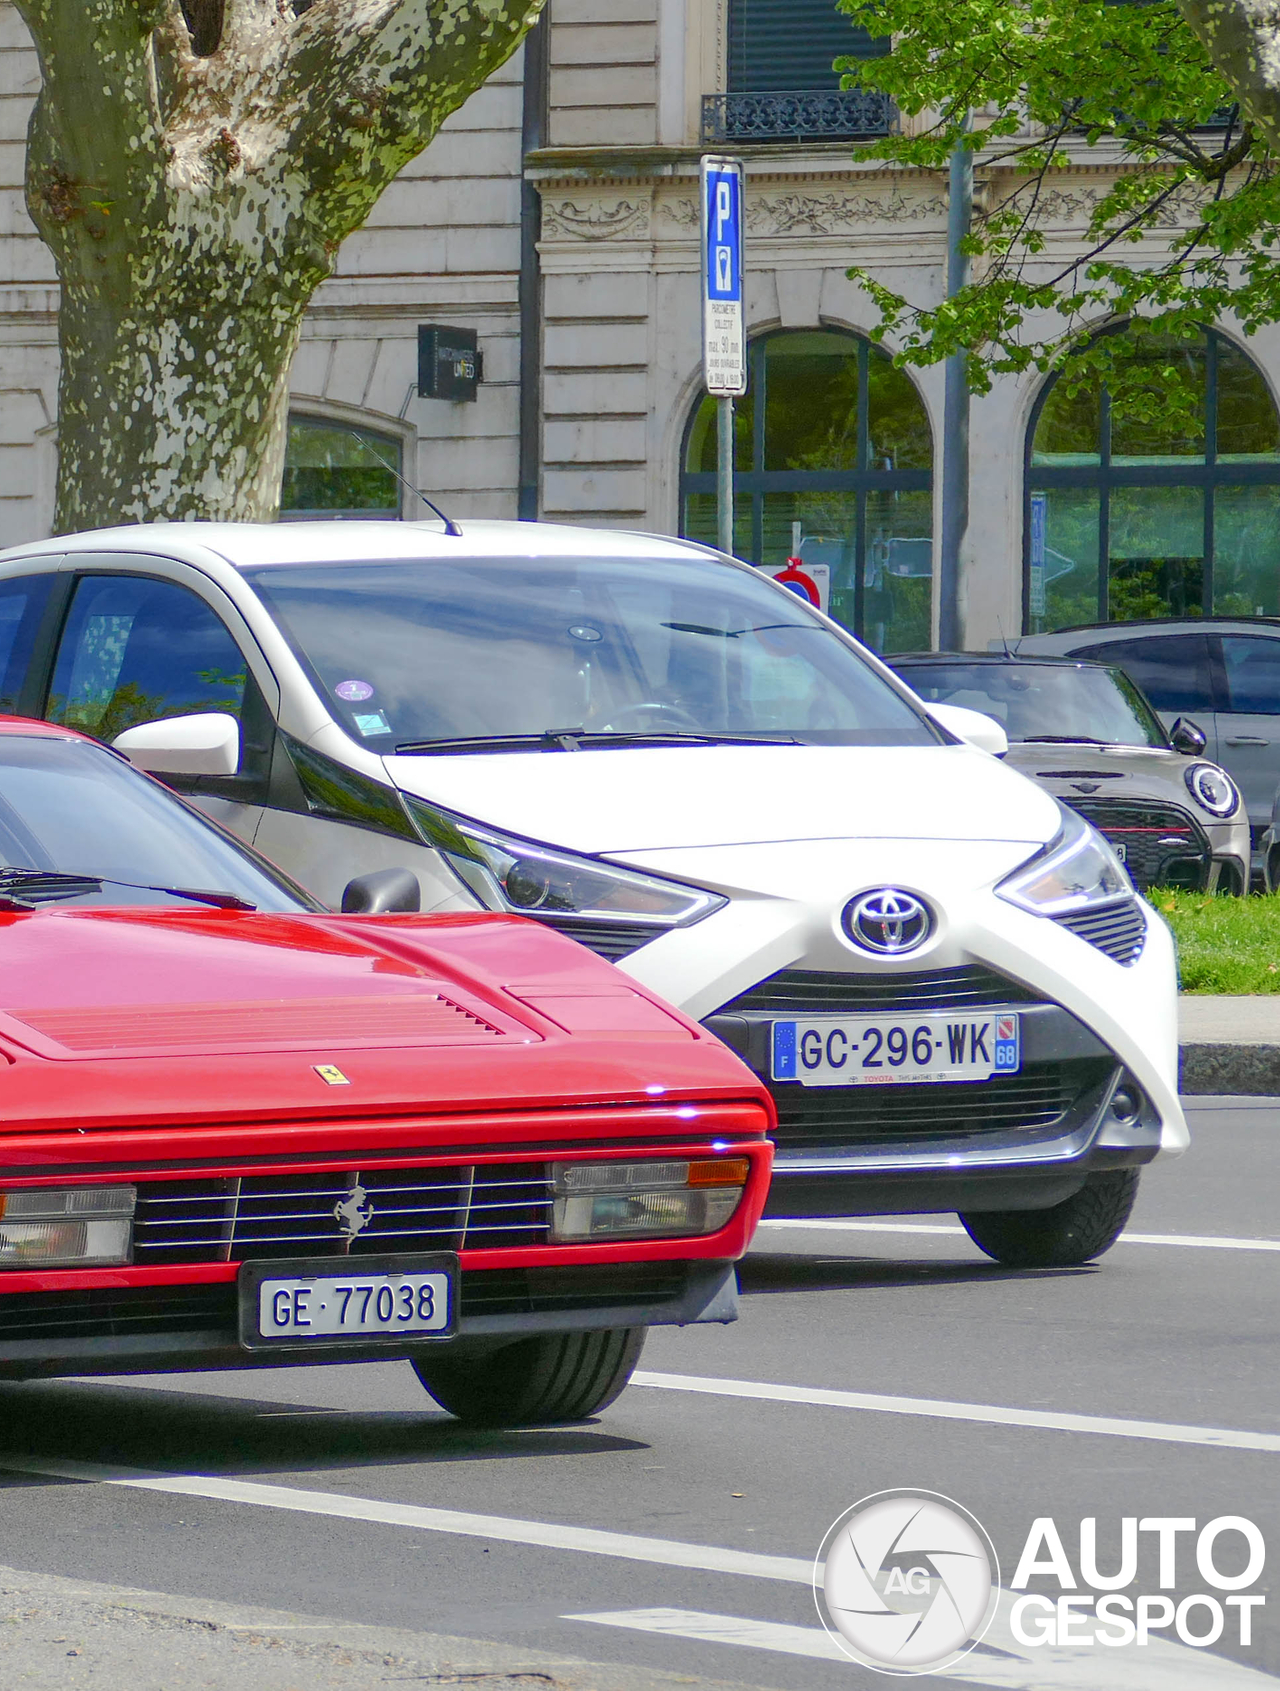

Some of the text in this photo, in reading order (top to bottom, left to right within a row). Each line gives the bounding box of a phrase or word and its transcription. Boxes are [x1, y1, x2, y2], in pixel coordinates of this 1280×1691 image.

[717, 181, 731, 241] P
[781, 1055, 788, 1067] F
[997, 1045, 1015, 1065] 68
[864, 1075, 894, 1083] TOYOTA
[335, 1284, 435, 1324] 77038
